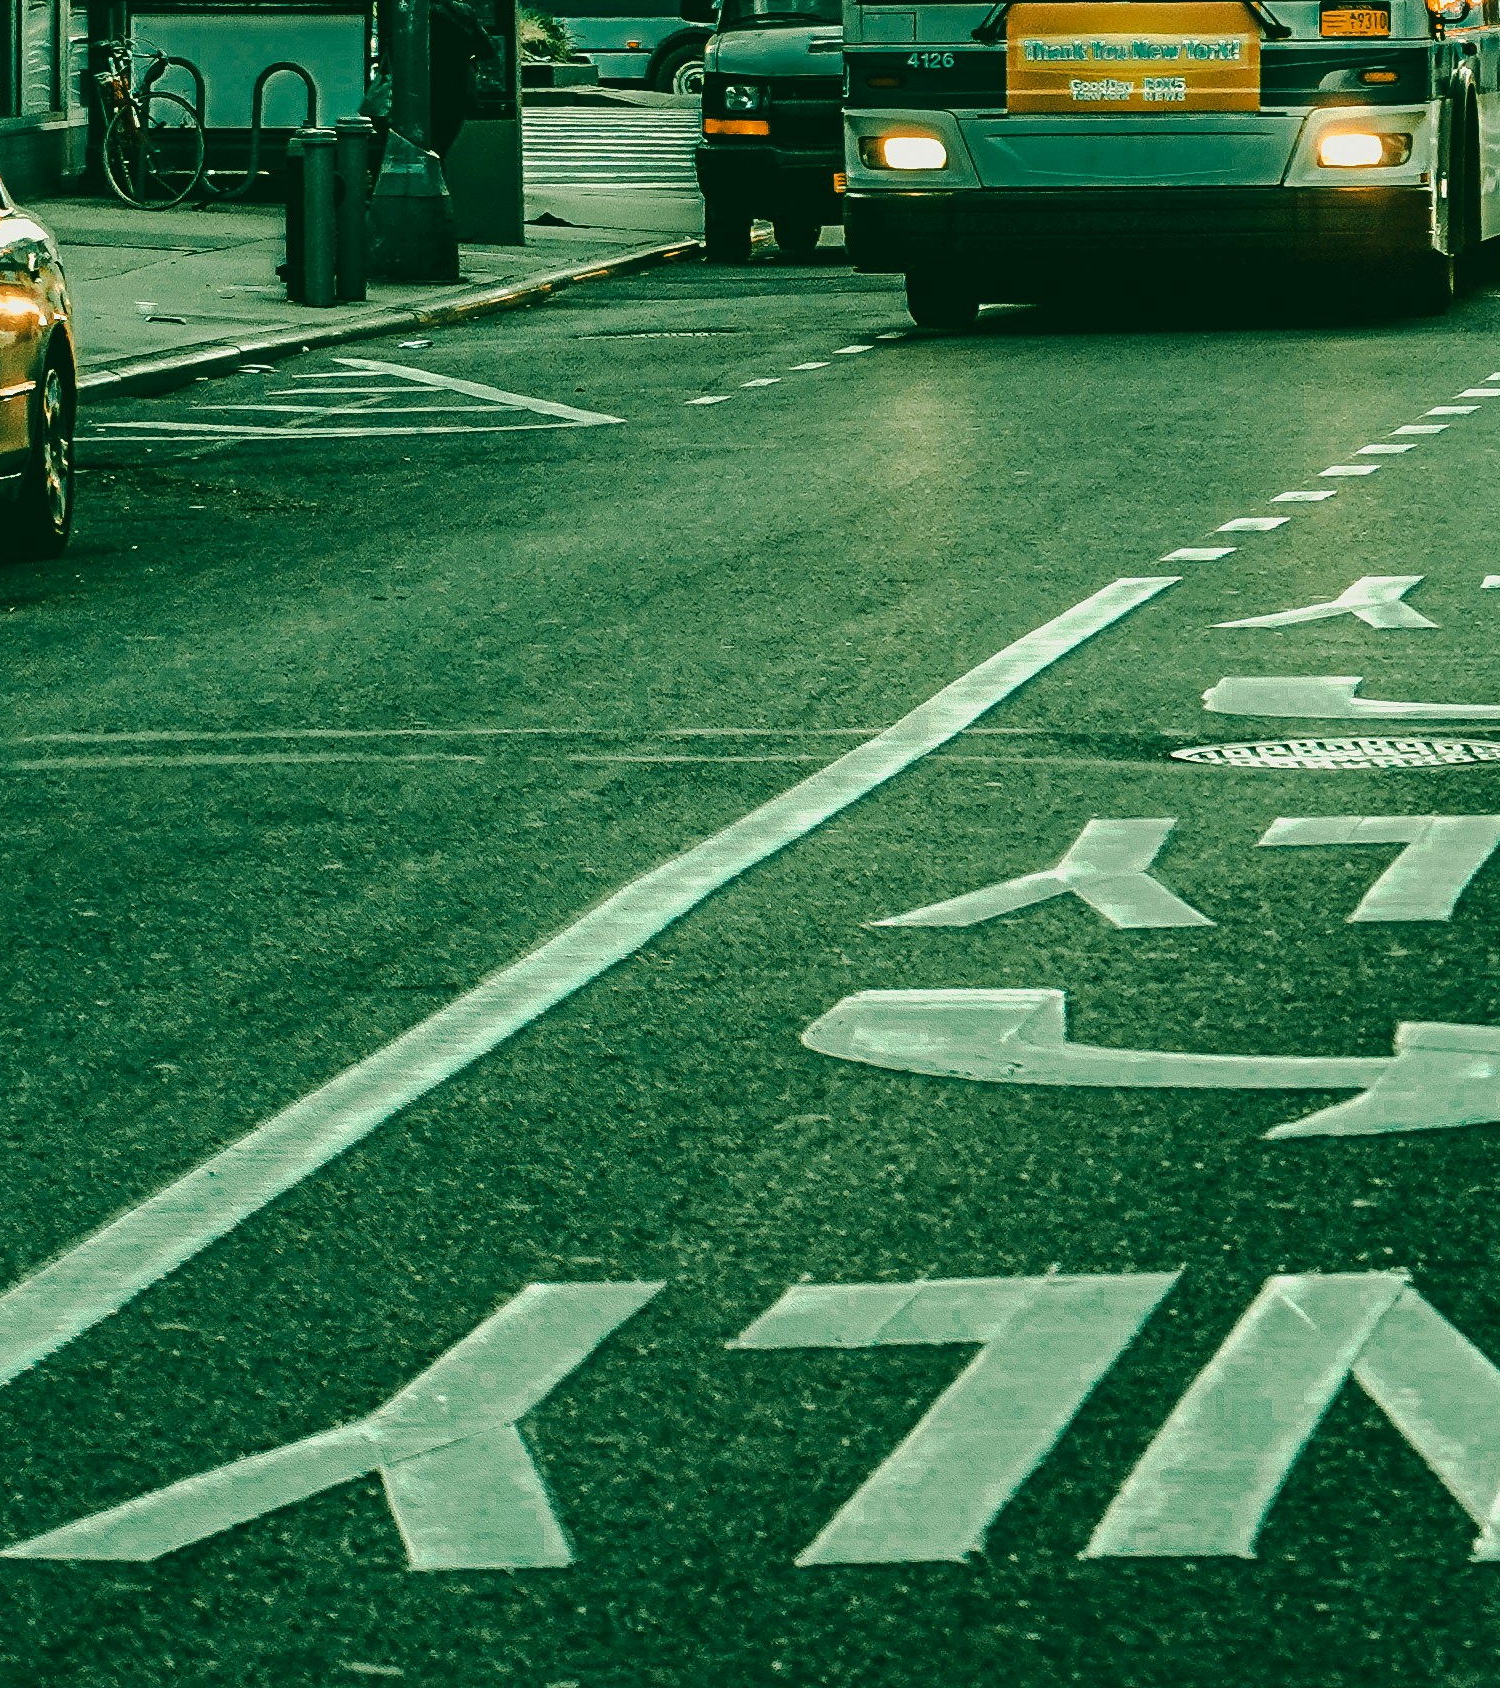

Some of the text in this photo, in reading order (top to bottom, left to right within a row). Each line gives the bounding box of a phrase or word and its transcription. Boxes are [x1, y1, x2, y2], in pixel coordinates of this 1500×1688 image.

[907, 52, 956, 68] 4126
[1023, 39, 1088, 62] Thank
[1091, 40, 1130, 61] You
[1132, 39, 1181, 61] New
